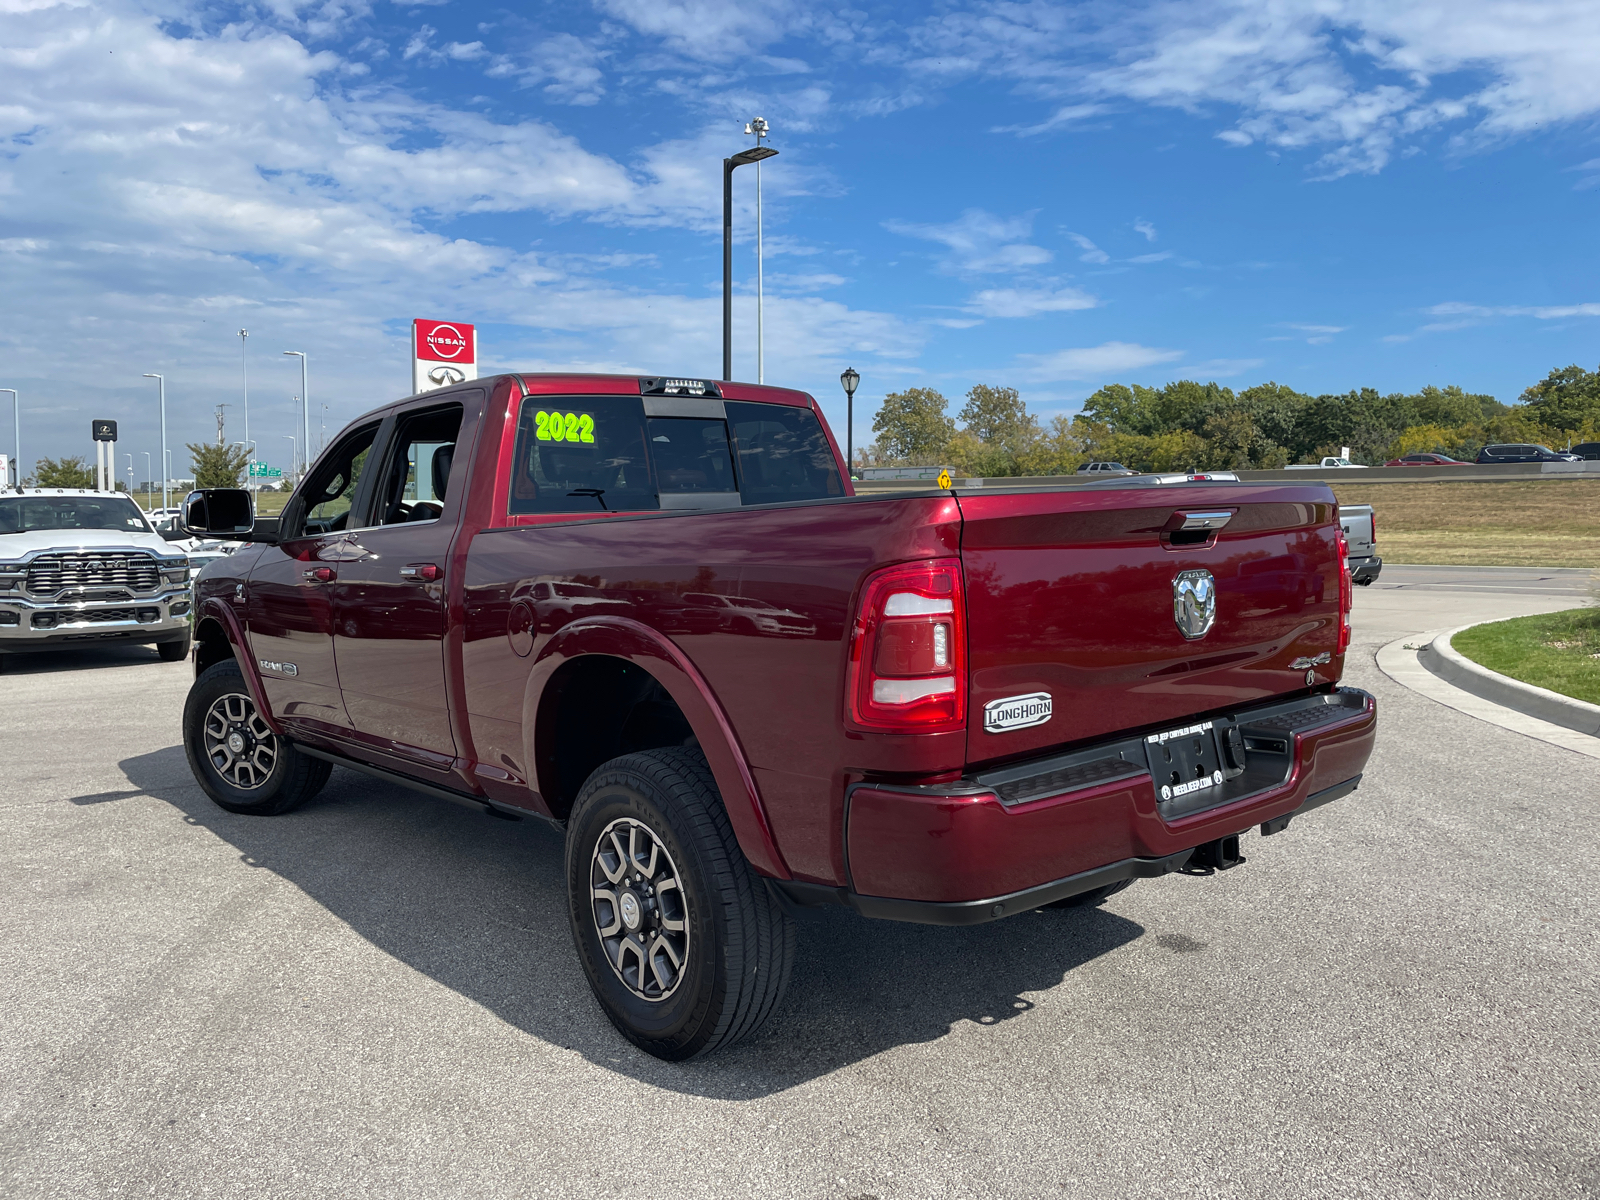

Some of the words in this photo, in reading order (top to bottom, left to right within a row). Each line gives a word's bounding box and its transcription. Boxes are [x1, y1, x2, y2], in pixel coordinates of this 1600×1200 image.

[427, 336, 466, 347] NISSAN
[535, 410, 595, 444] 2022
[63, 560, 126, 570] RAM
[260, 660, 282, 672] RAM
[988, 702, 1051, 724] LONGHORN
[1147, 734, 1159, 744] REED
[1159, 732, 1169, 741] JEEP
[1169, 727, 1189, 739] CHRYSLER
[1189, 723, 1202, 734] DODGE
[1202, 721, 1213, 730] RAM
